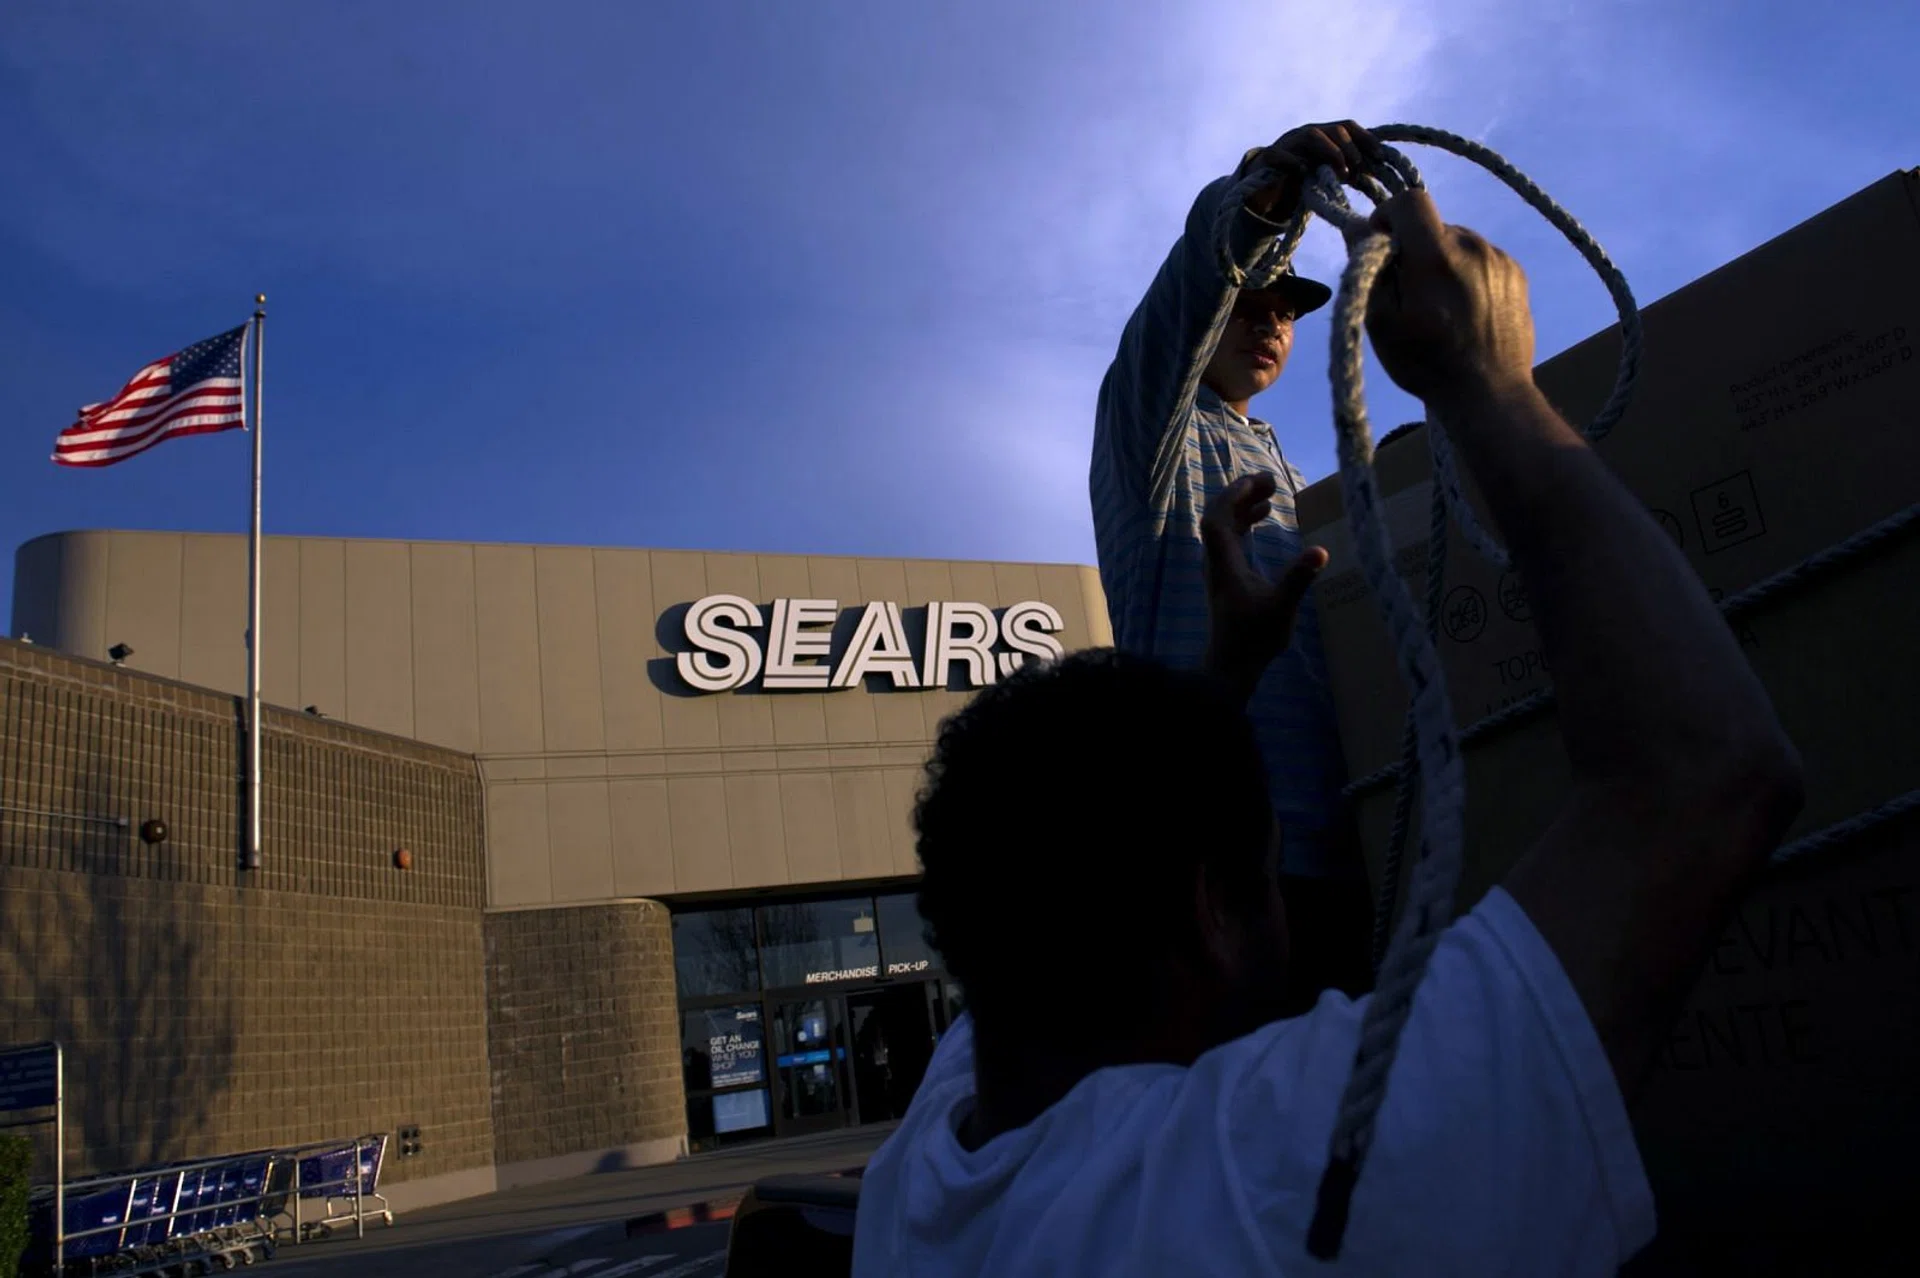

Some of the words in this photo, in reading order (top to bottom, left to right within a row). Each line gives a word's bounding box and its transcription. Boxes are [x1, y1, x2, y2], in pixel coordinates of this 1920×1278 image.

[1828, 355, 1843, 372] W
[1893, 325, 1906, 341] D
[1729, 366, 1776, 396] Product
[1774, 404, 1785, 420] H
[1834, 375, 1848, 391] W
[1900, 344, 1912, 362] D
[677, 595, 1064, 691] SEARS
[806, 965, 878, 983] MERCHANDISE
[888, 960, 929, 974] PICK-UP
[710, 1035, 727, 1046] GET
[729, 1033, 741, 1043] AN
[710, 1045, 725, 1055] OIL
[725, 1041, 760, 1053] CHANGE
[711, 1052, 736, 1062] WHILE
[739, 1050, 757, 1059] YOU
[711, 1061, 735, 1071] SHOP
